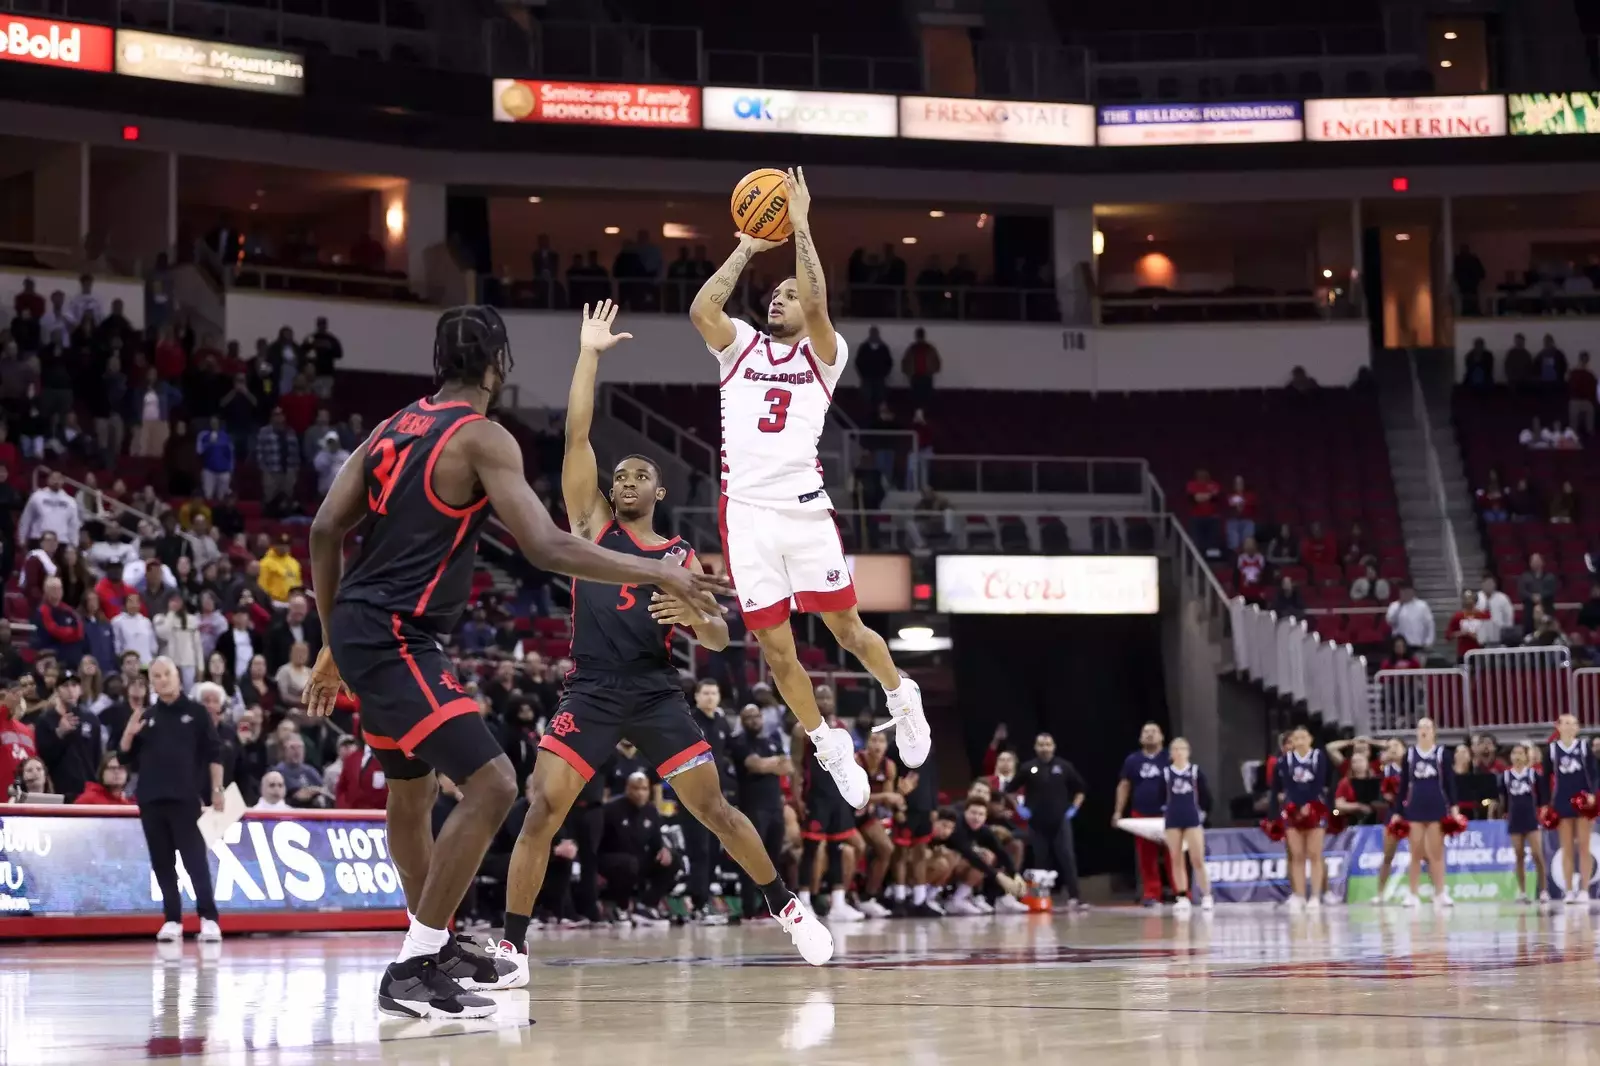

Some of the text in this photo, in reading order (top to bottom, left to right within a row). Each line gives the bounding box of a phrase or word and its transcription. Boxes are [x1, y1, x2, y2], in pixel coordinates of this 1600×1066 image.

[210, 50, 303, 78] Mountain
[924, 103, 1070, 127] FRESNO STATE
[1103, 105, 1294, 123] THE BULLDOG FOUNDATION
[1322, 117, 1491, 137] ENGINEERING
[737, 185, 761, 217] NCAA
[751, 195, 786, 234] Wilson
[743, 367, 814, 384] BULLDOGS
[758, 388, 792, 433] 3
[616, 583, 638, 611] 5
[982, 568, 1067, 600] Coors
[326, 828, 388, 860] HOT
[335, 861, 404, 894] GRO
[1206, 860, 1260, 881] BUD
